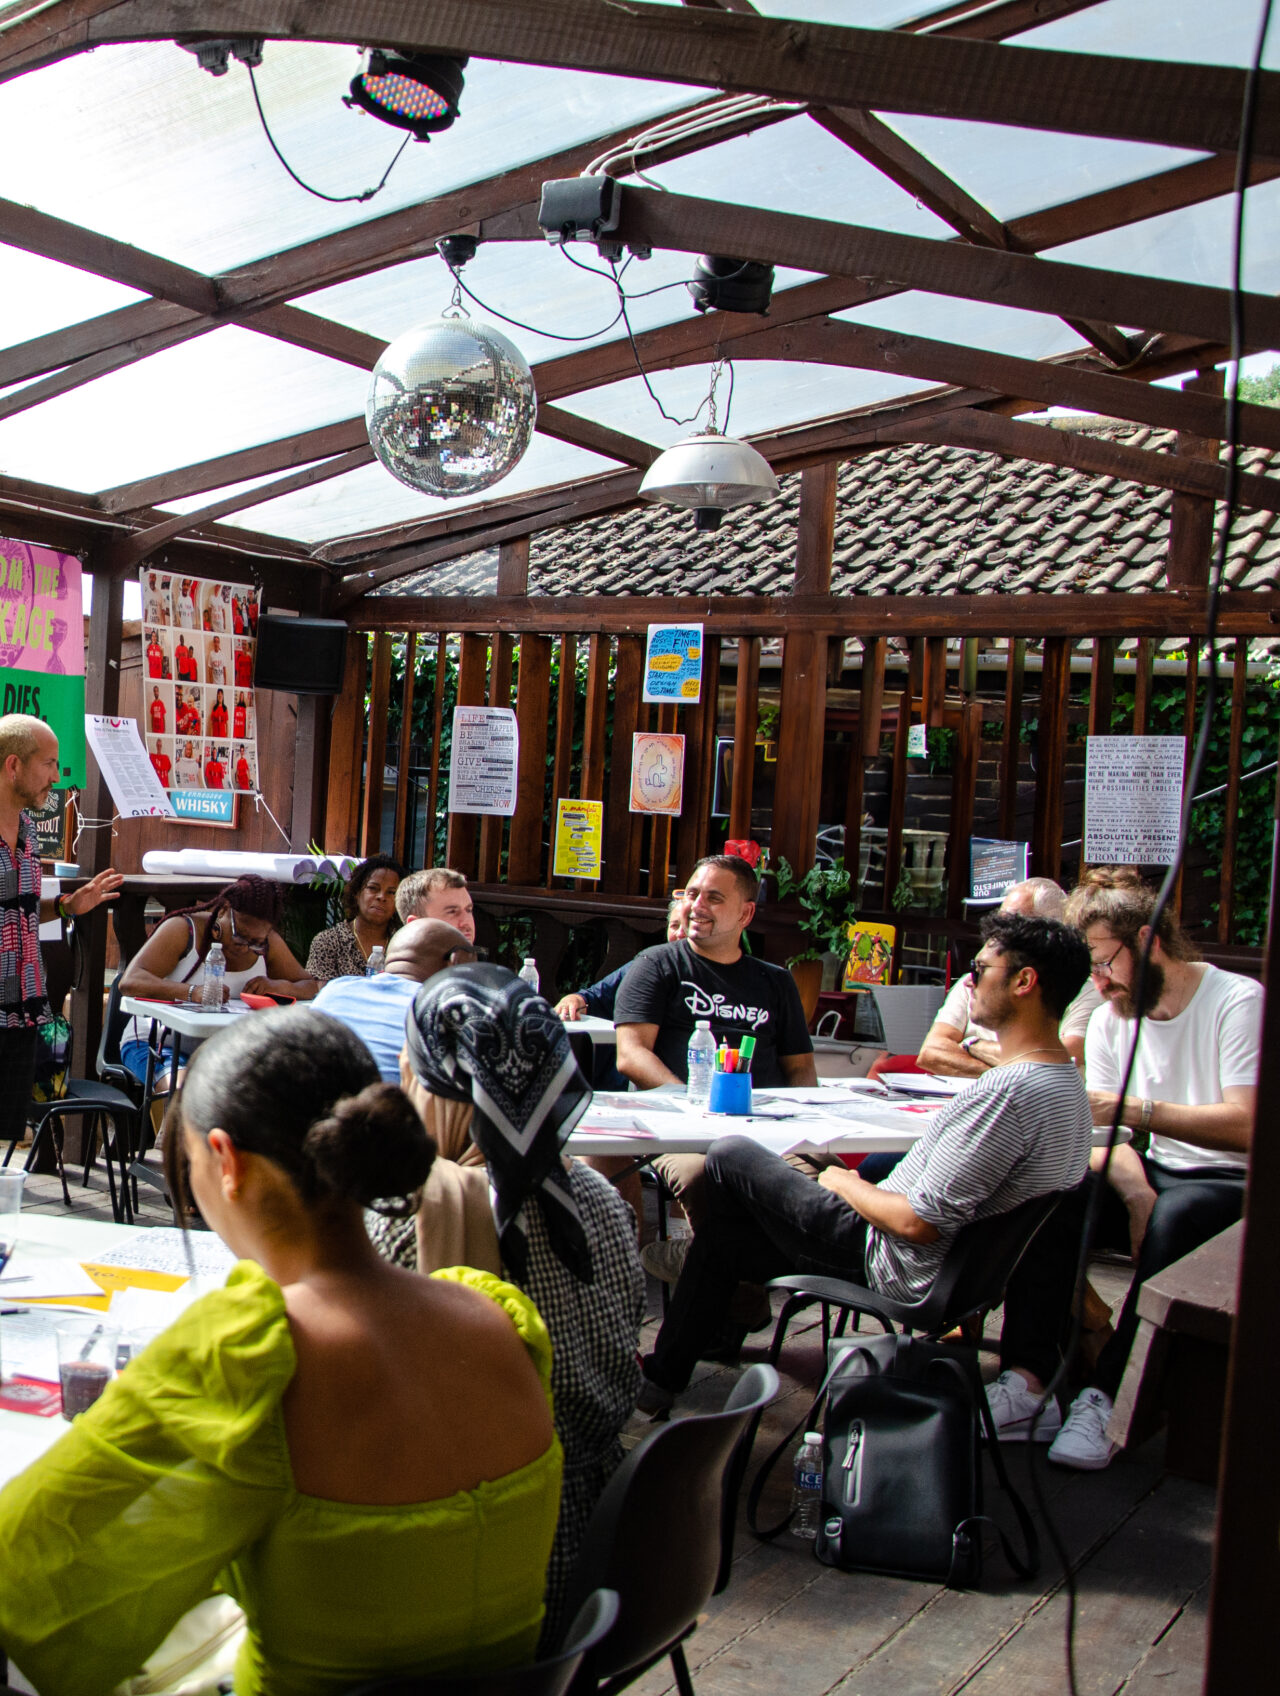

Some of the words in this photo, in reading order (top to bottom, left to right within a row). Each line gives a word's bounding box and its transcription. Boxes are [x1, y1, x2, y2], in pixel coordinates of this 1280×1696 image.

[34, 563, 60, 598] THE
[461, 714, 485, 722] LIFE
[460, 731, 473, 739] BE
[457, 757, 482, 766] GIVE
[176, 797, 229, 815] WHISKY
[493, 799, 511, 808] NOW
[36, 815, 61, 833] STOUT
[1088, 853, 1119, 861] FROM
[1123, 853, 1154, 862] HERE
[801, 1472, 822, 1485] ICE
